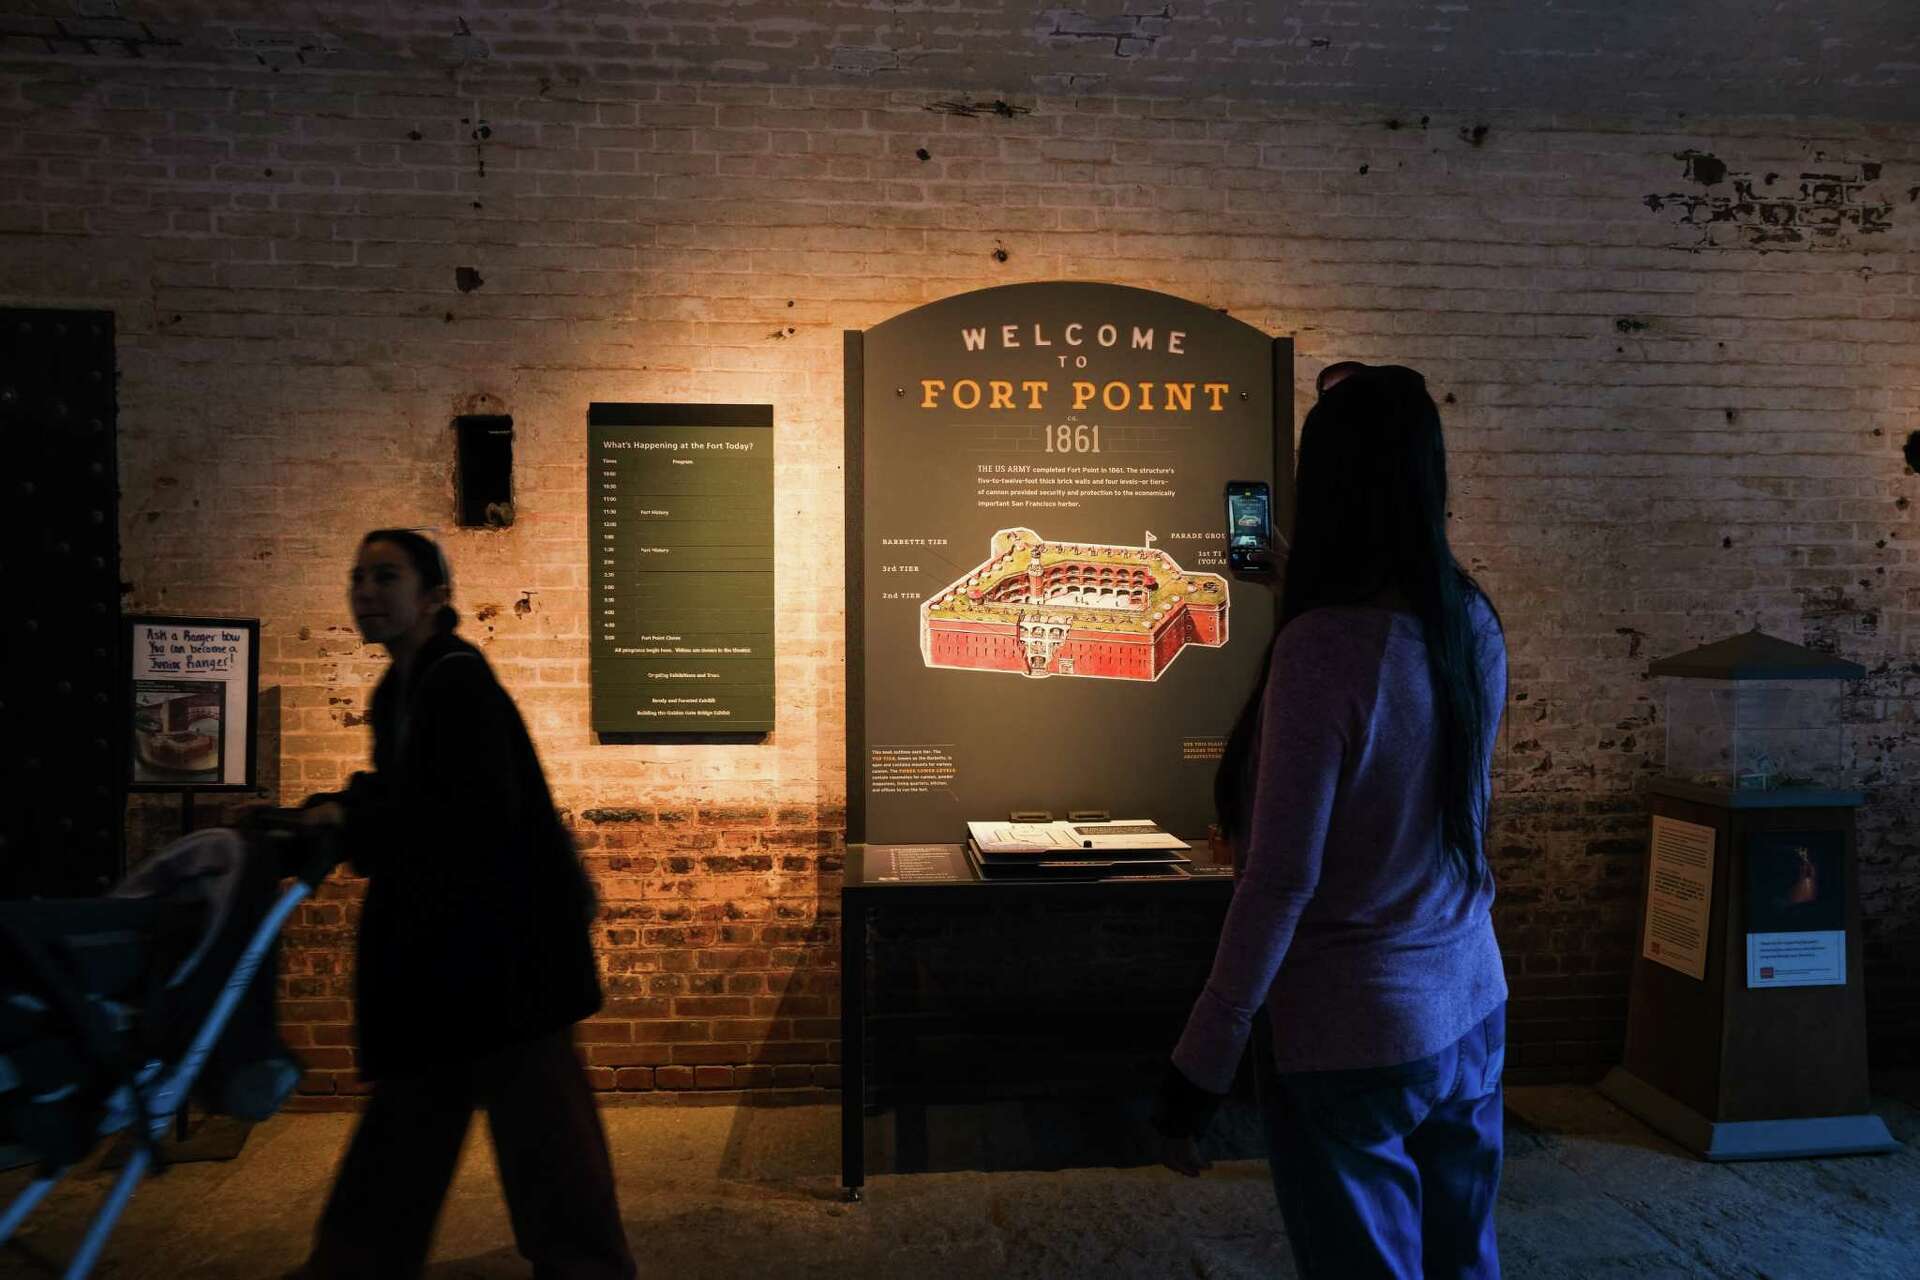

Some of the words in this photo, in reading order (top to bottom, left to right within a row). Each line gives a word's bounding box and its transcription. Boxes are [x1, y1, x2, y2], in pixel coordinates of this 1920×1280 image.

[962, 324, 1186, 354] WELCOME
[1058, 355, 1087, 368] TO
[920, 379, 1048, 410] FORT
[1072, 380, 1230, 411] POINT
[603, 440, 631, 449] What's
[633, 441, 678, 451] Happening
[691, 441, 704, 449] the
[725, 441, 754, 451] Today?
[1045, 424, 1101, 453] 1861
[978, 465, 993, 473] THE
[995, 465, 1006, 473] US
[1007, 465, 1031, 473] ARMY
[1033, 466, 1066, 474] completed
[171, 632, 178, 641] a
[183, 629, 215, 646] Ranger
[148, 641, 165, 653] You
[190, 643, 227, 654] become
